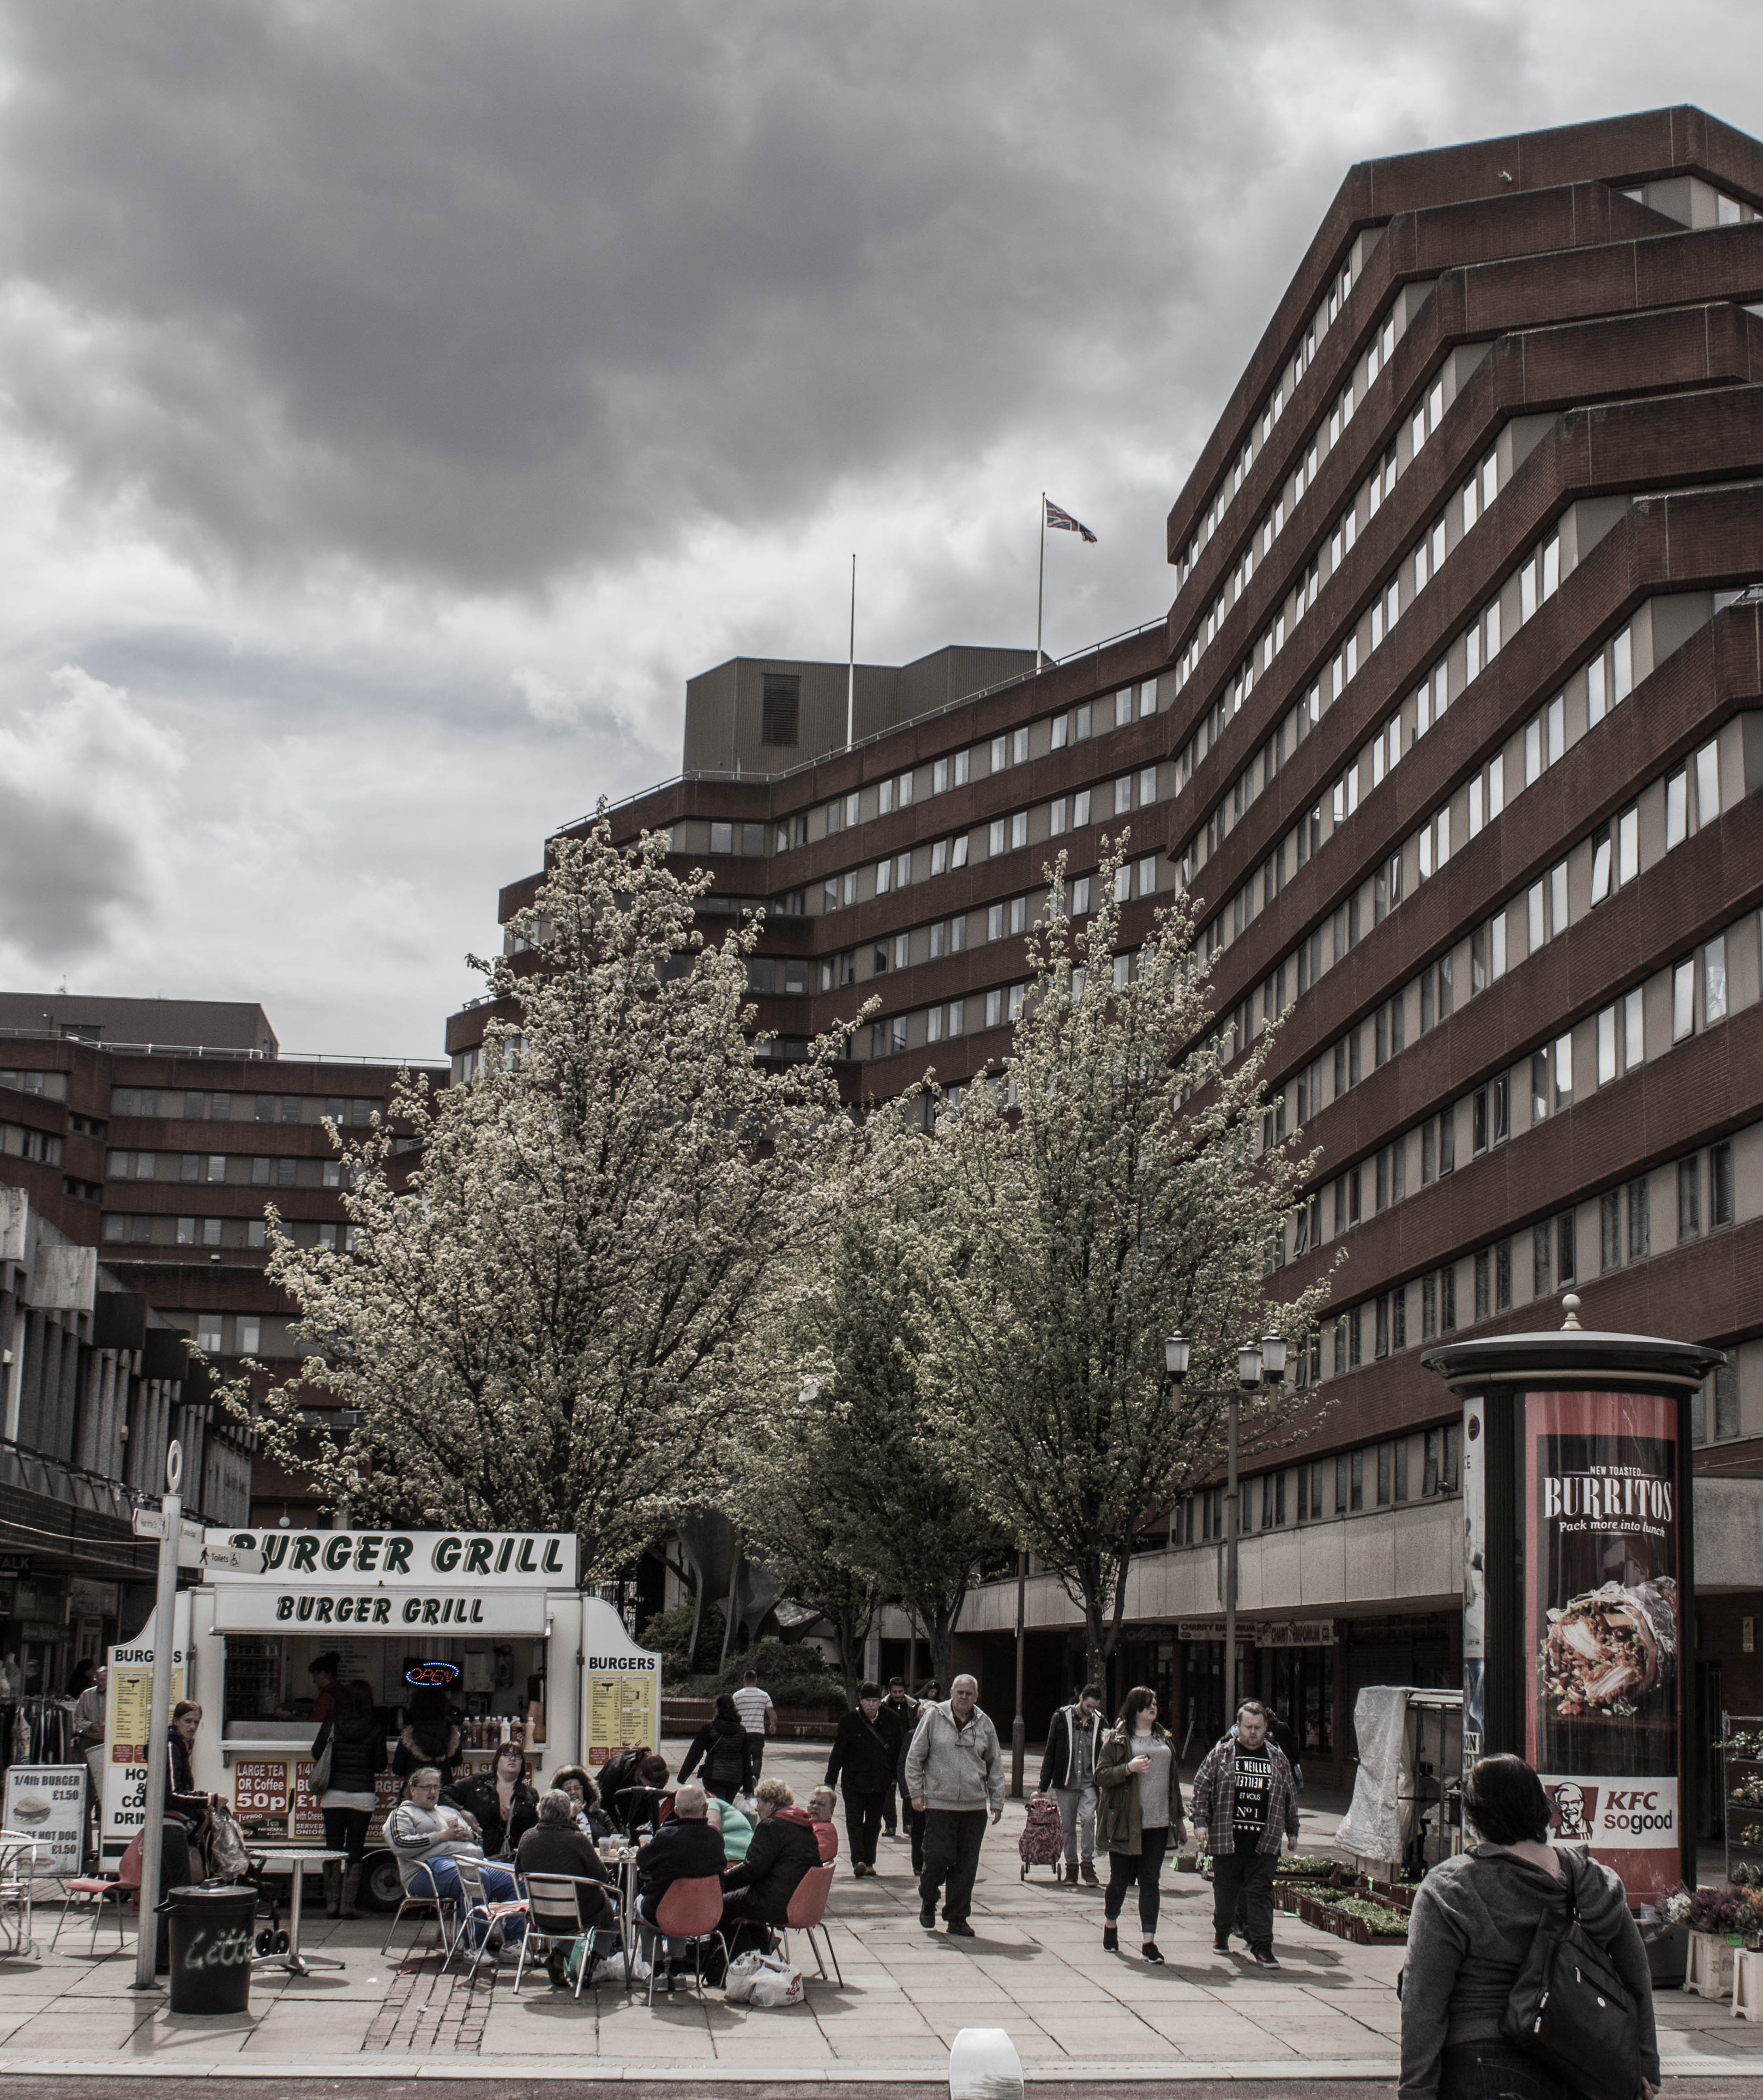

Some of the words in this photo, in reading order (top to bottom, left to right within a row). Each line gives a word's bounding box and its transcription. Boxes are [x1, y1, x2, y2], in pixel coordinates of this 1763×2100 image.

[1590, 1465, 1606, 1475] NEW
[1609, 1466, 1641, 1476] TOASTED
[1543, 1477, 1672, 1522] BURRITOS
[1559, 1519, 1587, 1532] Pack
[1590, 1520, 1618, 1529] more
[1620, 1519, 1640, 1531] into
[1642, 1522, 1665, 1537] lunch
[211, 1553, 229, 1563] Toilets
[431, 1536, 564, 1576] GRILL
[276, 1595, 392, 1625] BURGER
[401, 1597, 484, 1624] GRILL
[115, 1649, 182, 1663] BURGS
[589, 1657, 655, 1670] BURGERS
[409, 1667, 455, 1683] OPEN
[237, 1764, 266, 1776] LARGE
[268, 1764, 285, 1777] TEA
[1244, 1761, 1271, 1773] MEILLEU
[14, 1775, 39, 1786] 1/4lb
[41, 1775, 80, 1786] BURGER
[125, 1769, 147, 1781] HO
[136, 1782, 146, 1794] &
[238, 1778, 252, 1790] OR
[254, 1778, 284, 1791] Coffee
[52, 1790, 79, 1801] £1.50
[122, 1795, 146, 1807] CO
[1247, 1793, 1261, 1801] VOUS
[1604, 1791, 1658, 1811] KFC
[237, 1793, 286, 1811] 50p
[266, 1818, 280, 1826] Tea
[39, 1831, 57, 1840] HOT
[58, 1831, 77, 1840] DOG
[52, 1844, 76, 1854] £1.50
